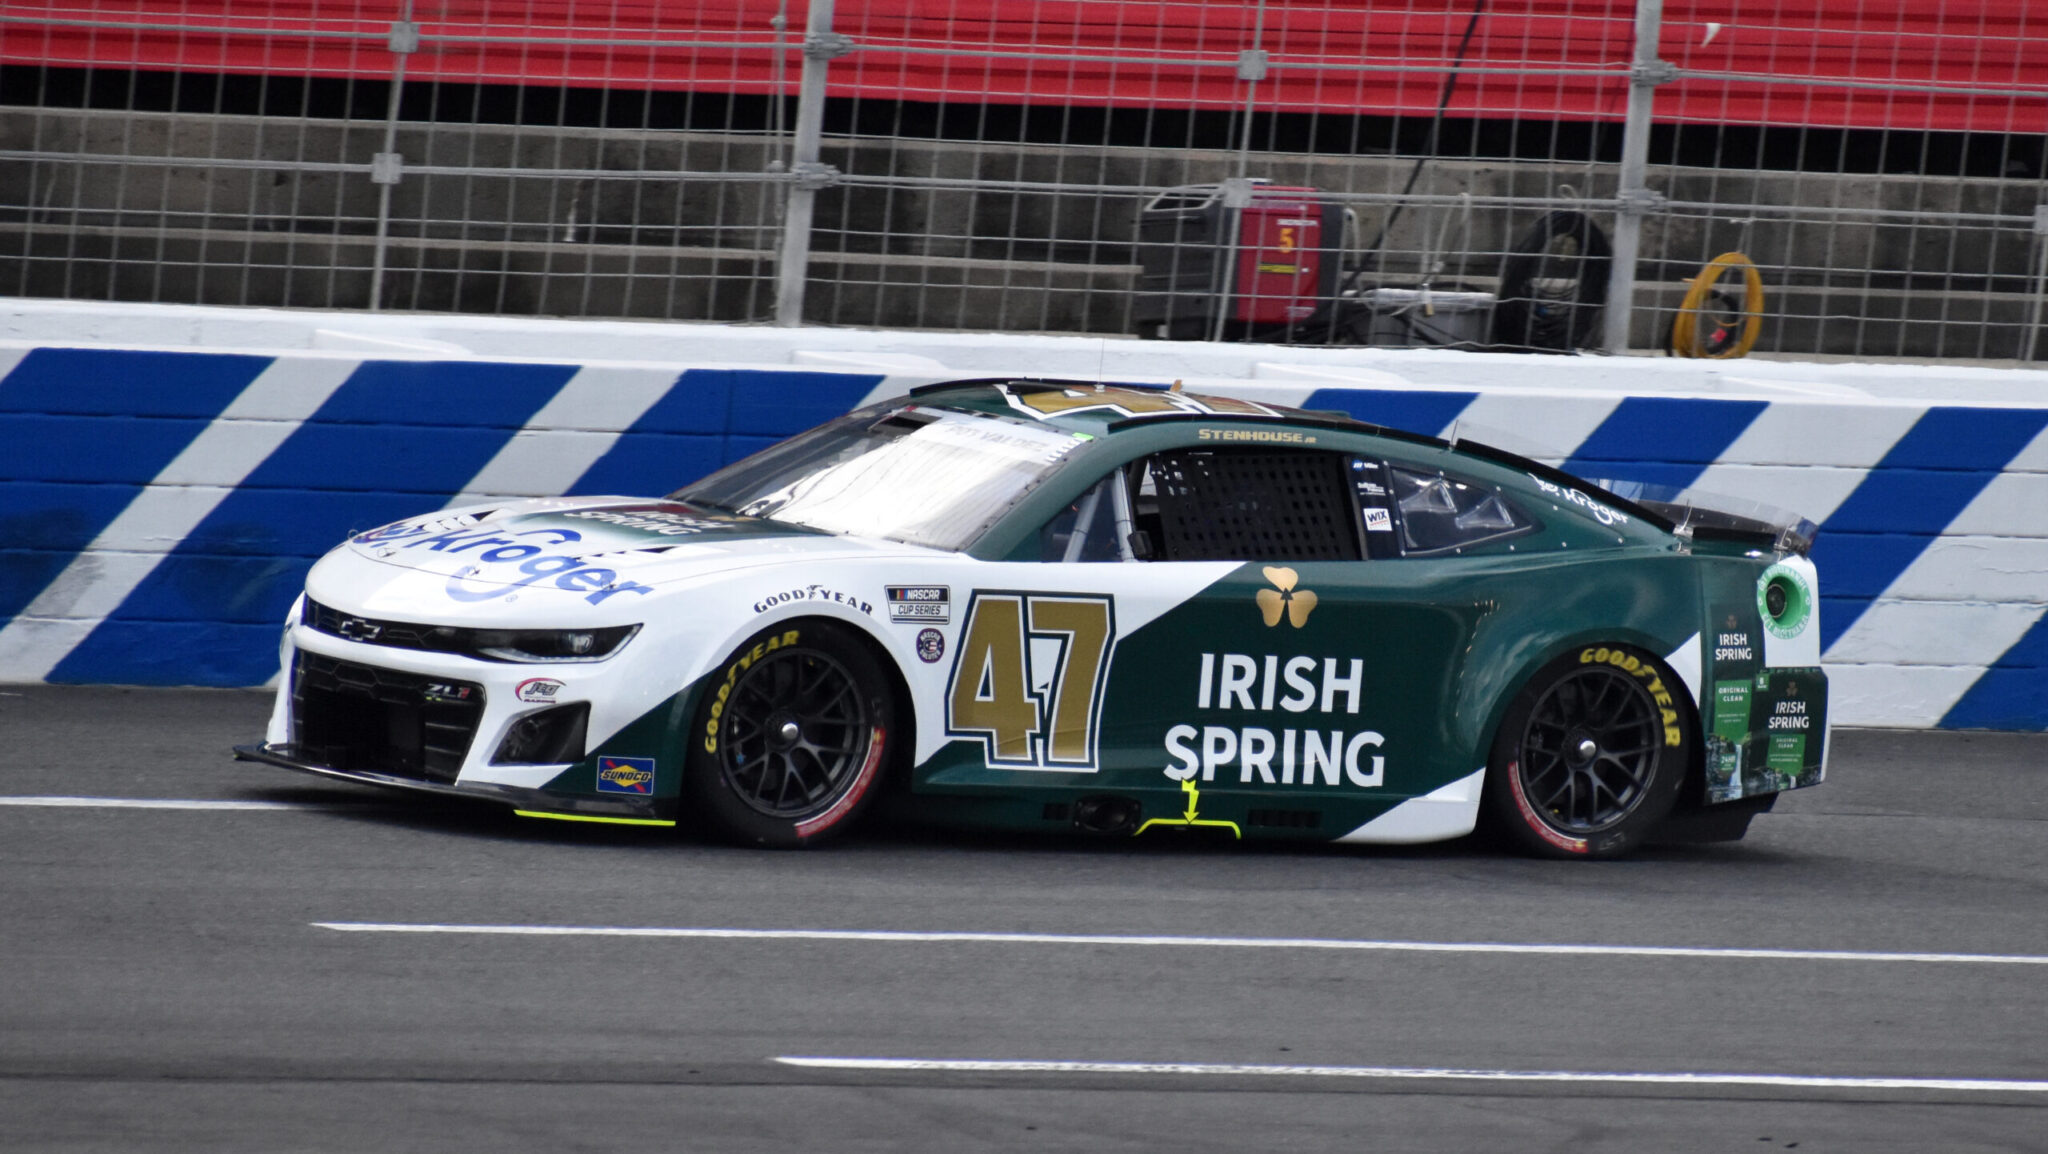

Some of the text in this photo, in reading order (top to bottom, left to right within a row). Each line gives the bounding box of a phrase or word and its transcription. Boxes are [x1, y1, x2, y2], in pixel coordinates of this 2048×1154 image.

[1280, 227, 1294, 253] 5
[1198, 428, 1303, 443] STENHOUSE
[1562, 487, 1628, 526] Kroger
[1367, 511, 1387, 522] WIX
[402, 528, 655, 607] Kroger
[908, 588, 941, 600] NASCAR
[898, 605, 941, 615] CUP SERIES
[1719, 632, 1748, 646] IRISH
[1715, 647, 1753, 661] SPRING
[945, 588, 1116, 773] 47
[1197, 652, 1364, 714] IRISH
[704, 629, 800, 754] GOODYEAR
[1579, 647, 1681, 748] GOODYEAR
[1718, 687, 1748, 695] ORIGINAL
[1722, 695, 1744, 703] CLEAN
[1775, 701, 1806, 715] IRISH
[1768, 716, 1810, 730] SPRING
[1162, 723, 1386, 788] SPRING
[602, 769, 650, 782] SUNOCO
